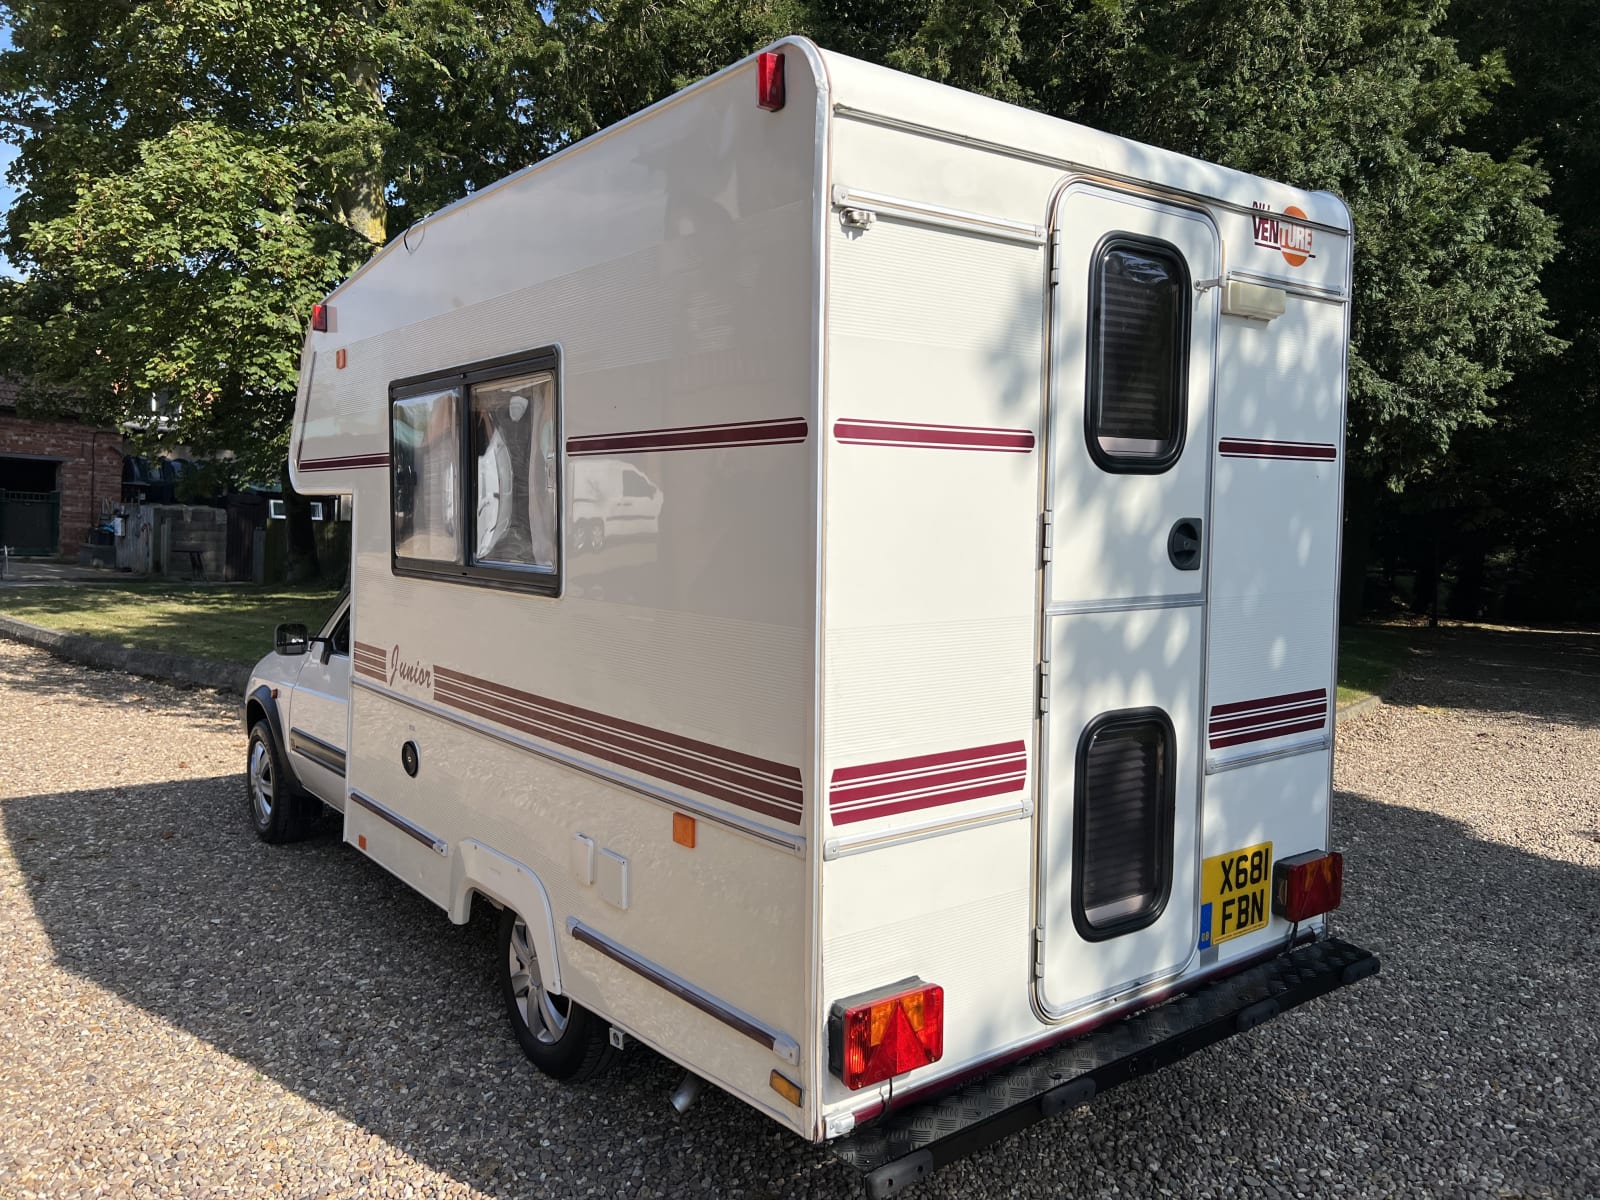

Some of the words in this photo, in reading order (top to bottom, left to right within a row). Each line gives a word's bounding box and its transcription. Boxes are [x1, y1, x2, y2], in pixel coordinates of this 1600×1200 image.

[1252, 216, 1312, 250] VENTURE
[390, 644, 431, 688] Junior
[1220, 848, 1269, 896] X681
[1221, 888, 1264, 935] FBN
